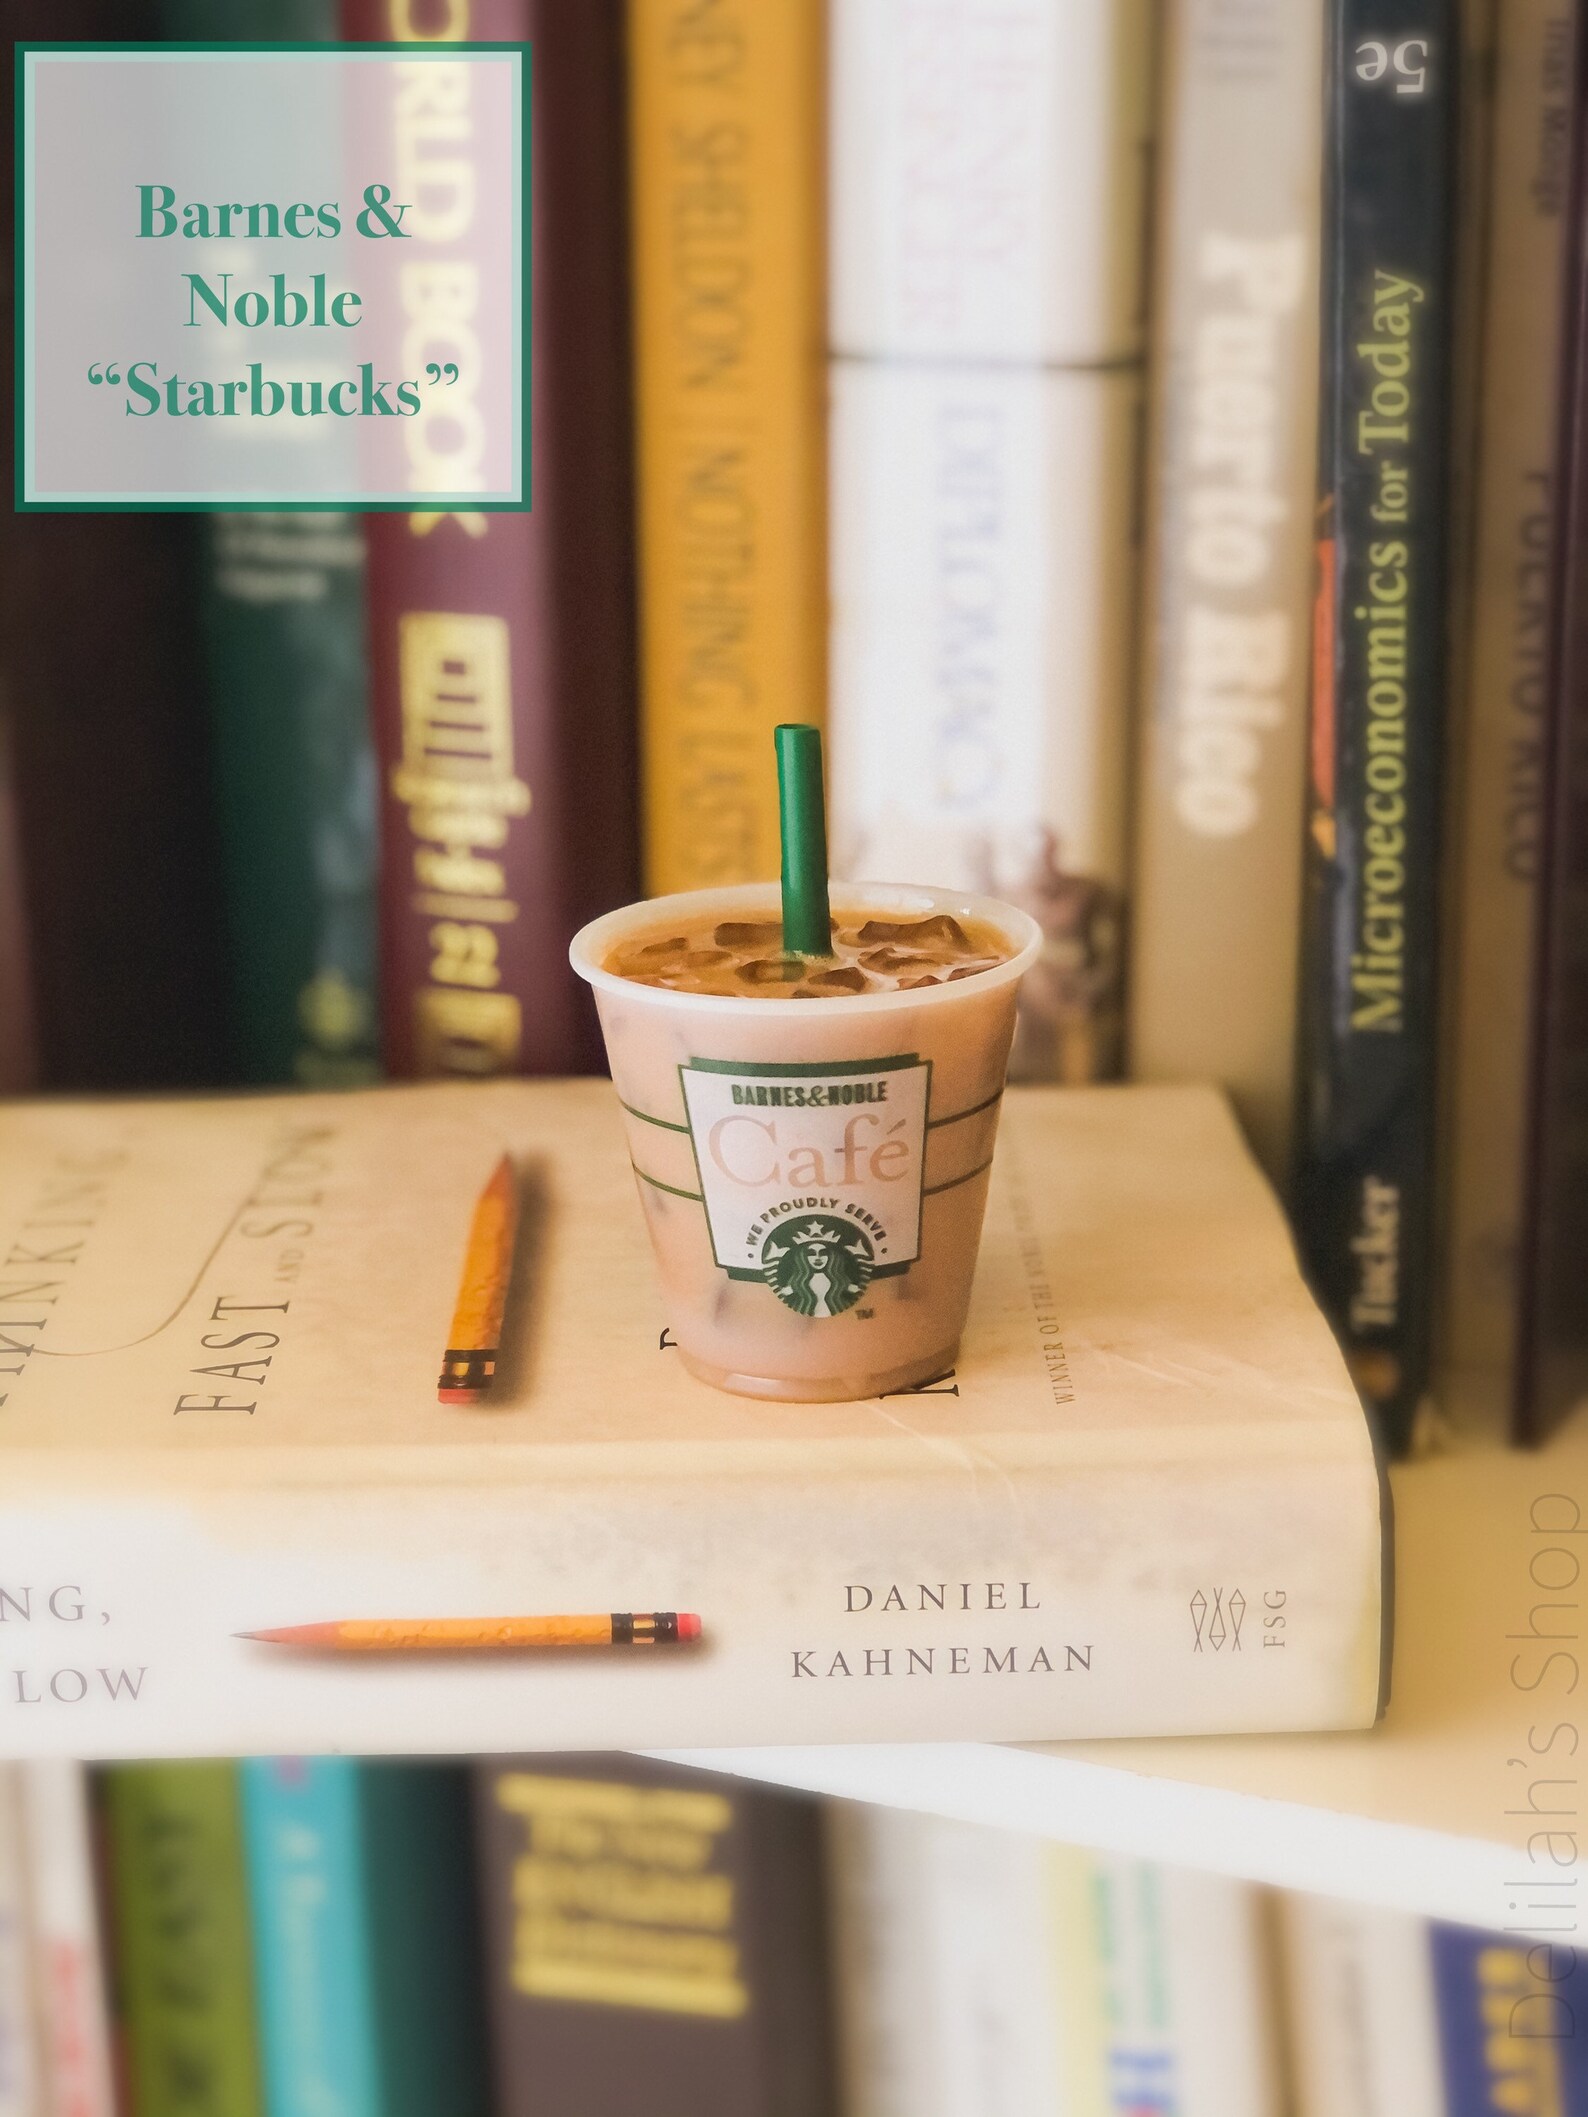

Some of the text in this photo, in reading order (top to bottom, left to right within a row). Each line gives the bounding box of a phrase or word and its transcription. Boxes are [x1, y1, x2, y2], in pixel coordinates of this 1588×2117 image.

[1355, 40, 1427, 93] 5e
[1184, 231, 1310, 588] Puerto
[1351, 268, 1425, 1034] Microeconomics for Today
[731, 1081, 888, 1107] BARNES&NOBLE
[708, 1113, 910, 1188] Café
[745, 1196, 888, 1246] WE PROUDLY SERVE
[1036, 1315, 1060, 1335] OF
[173, 1296, 290, 1416] FAST
[1043, 1342, 1077, 1405] WINNER
[844, 1581, 1041, 1613] DANIEL
[1262, 1589, 1287, 1650] FSG
[790, 1644, 1095, 1679] KAHNEMAN
